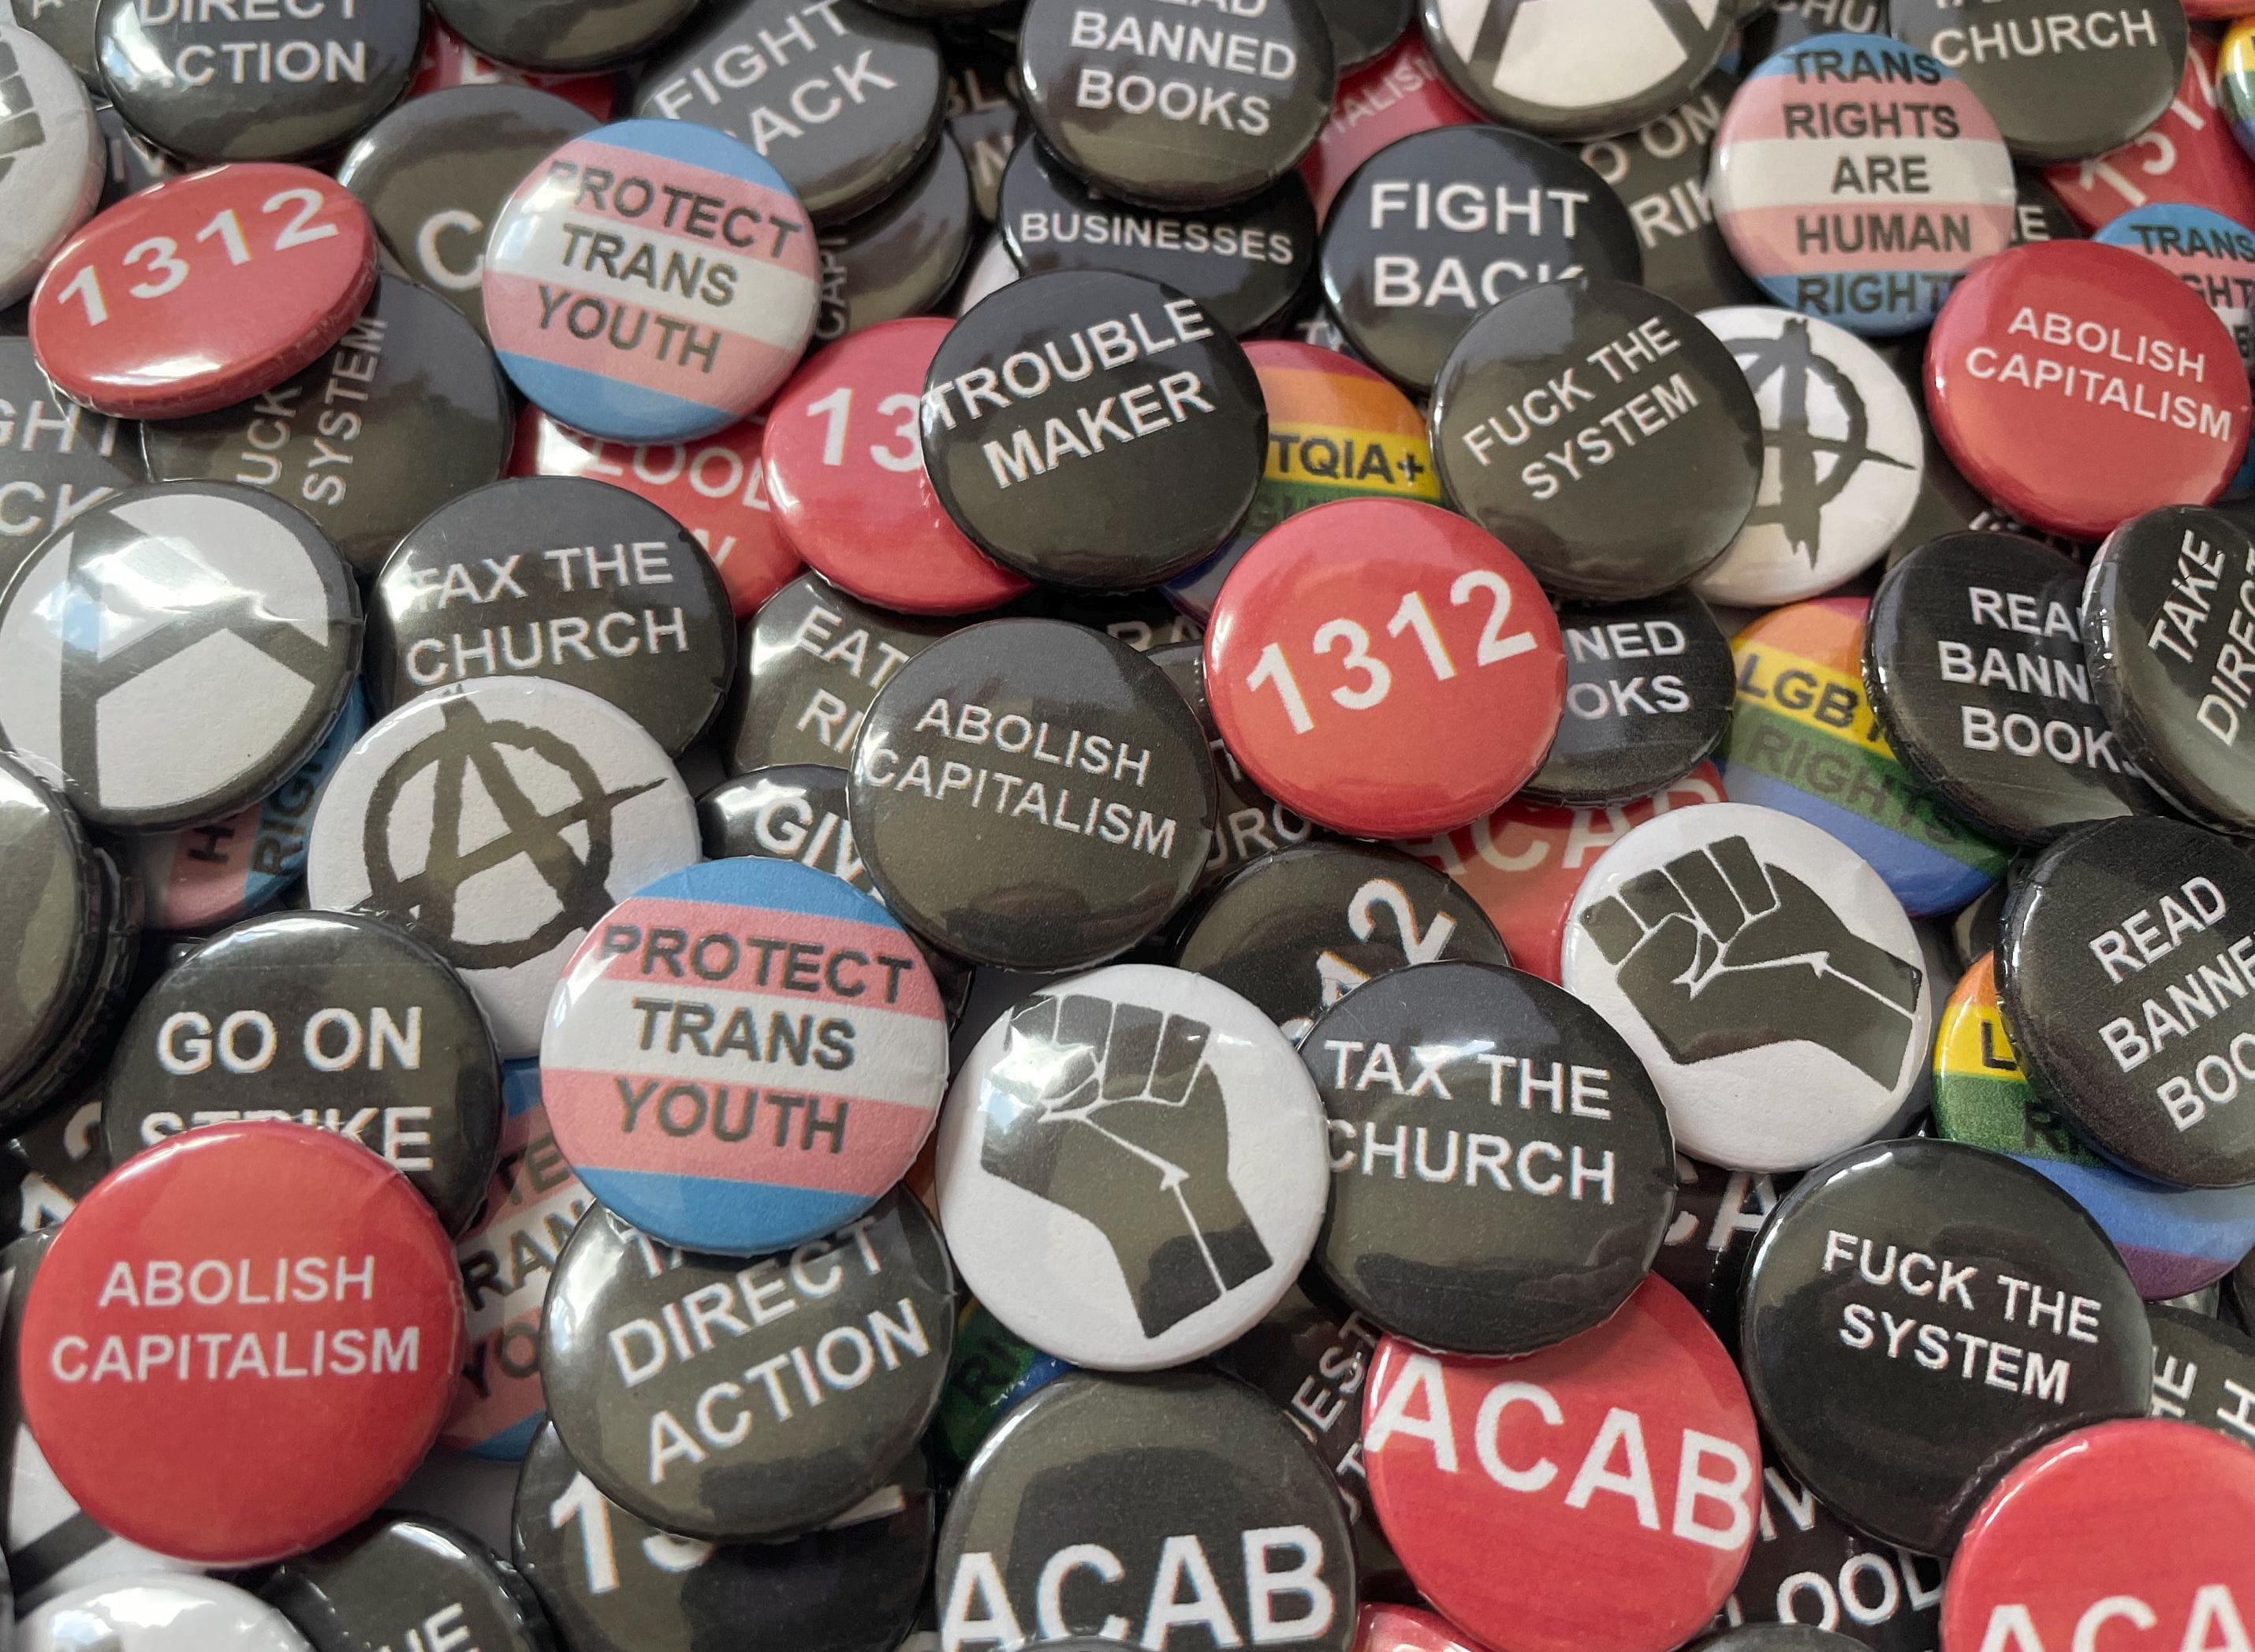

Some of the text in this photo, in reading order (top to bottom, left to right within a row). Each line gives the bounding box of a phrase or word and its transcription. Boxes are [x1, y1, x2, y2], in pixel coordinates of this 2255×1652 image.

[129, 41, 366, 91] CTION
[654, 0, 849, 120] FIGHT
[1070, 10, 1297, 80] BANNED
[1787, 50, 1941, 85] TRANS
[1931, 10, 2159, 66] CHURCH
[724, 50, 897, 156] ACK
[1076, 68, 1271, 136] BOOKS
[1784, 103, 1960, 140] RIGHTS
[554, 160, 803, 259] PROTECT
[1369, 182, 1590, 239] FIGHT
[1831, 156, 1931, 194] ARE
[58, 188, 339, 326] 1312
[561, 222, 739, 308] TRANS
[1021, 212, 1295, 266] BUSINESSES
[1795, 214, 1971, 255] HUMAN
[1375, 256, 1585, 308] BAC
[538, 285, 721, 374] YOUTH
[923, 299, 1213, 430] TROUBLE
[2007, 306, 2206, 383] ABOLISH
[303, 315, 389, 505] SYSTEM
[983, 371, 1217, 489] MAKER
[1463, 317, 1682, 468] FUCK THE
[1966, 346, 2232, 443] CAPITALISM
[1522, 373, 1699, 502] SYSTEM
[410, 554, 529, 613] TAX
[544, 541, 674, 593] THE
[1969, 586, 2086, 643] REA
[2148, 529, 2226, 663] TAKE
[405, 606, 689, 686] CHURCH
[793, 605, 910, 690] EAT
[1246, 569, 1538, 735] 1312
[915, 698, 1152, 788] ABOLISH
[866, 748, 1177, 860] CAPITALISM
[601, 924, 915, 1005] PROTECT
[2089, 875, 2227, 984] READ
[158, 1006, 423, 1076] GO ON
[632, 997, 856, 1072] TRANS
[614, 1077, 849, 1155] YOUTH
[1324, 1039, 1612, 1121] TAX THE
[1327, 1119, 1616, 1206] CHURCH
[99, 1255, 375, 1309] ABOLISH
[608, 1216, 882, 1388] DIRECT
[1821, 1229, 2103, 1344] FUCK THE
[50, 1326, 420, 1383] CAPITALISM
[649, 1296, 930, 1484] ACTION
[1839, 1302, 2072, 1404] SYSTEM
[1362, 1353, 1754, 1553] ACAB
[941, 1524, 1335, 1652] ACAB
